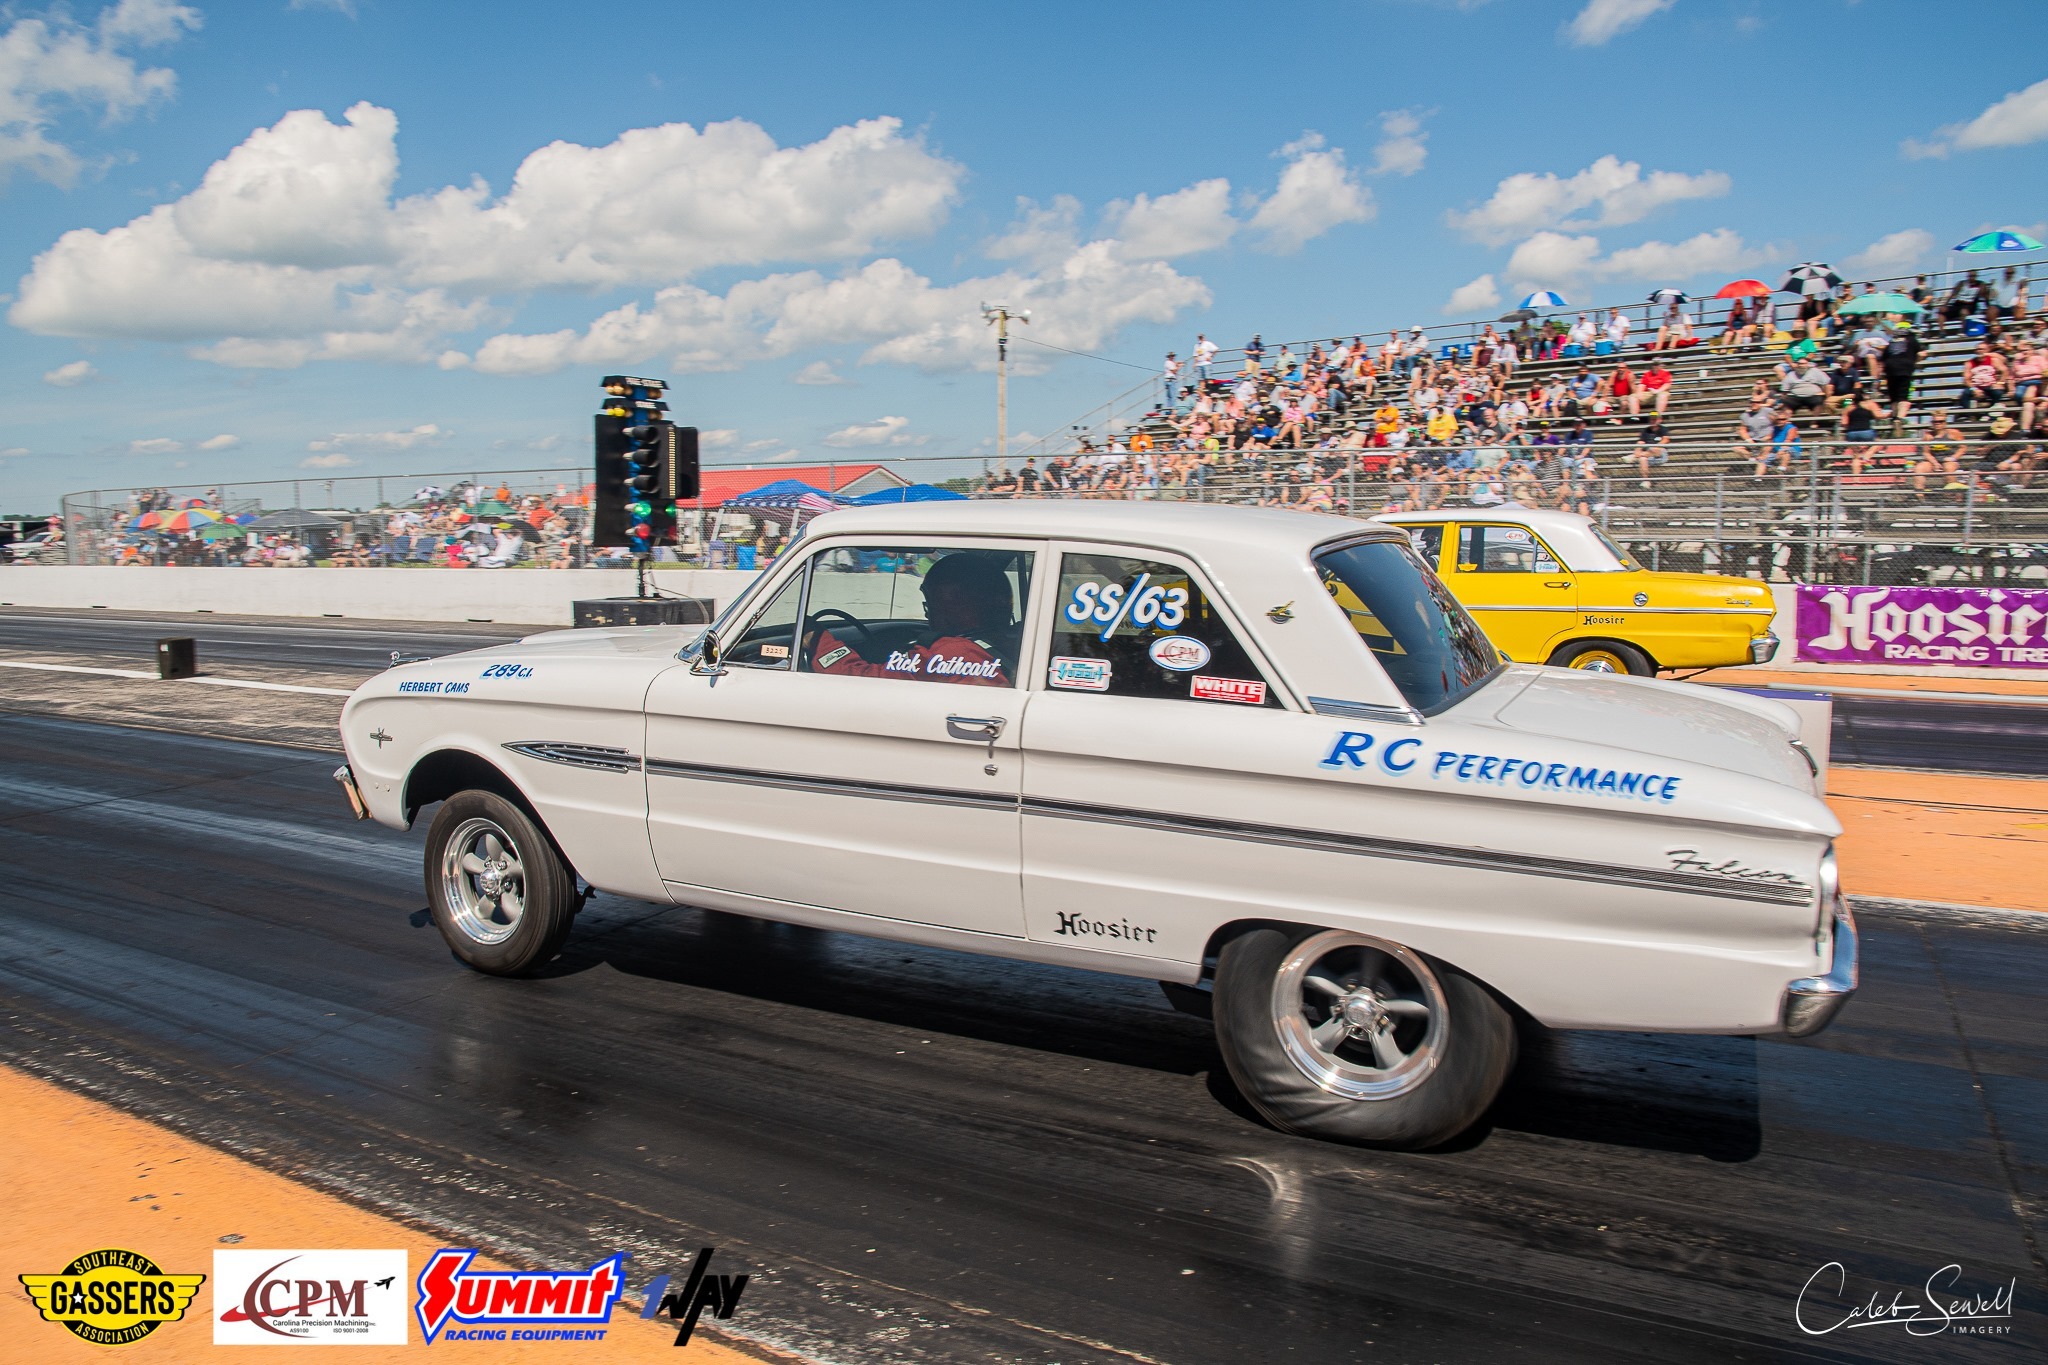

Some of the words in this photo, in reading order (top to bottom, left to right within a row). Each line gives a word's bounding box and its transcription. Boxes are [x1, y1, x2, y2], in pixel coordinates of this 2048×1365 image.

[1066, 573, 1188, 641] SS/63
[1808, 588, 2048, 651] Hoosie
[885, 650, 921, 673] Rick
[926, 654, 1002, 678] Cathcart
[1884, 644, 1990, 661] RACING
[481, 664, 521, 678] 289
[399, 682, 443, 693] HERBERT
[444, 682, 470, 694] CAMS
[1196, 678, 1262, 695] WHITE
[1434, 751, 1682, 802] PERFORMANCE
[1053, 910, 1158, 943] Hoosier
